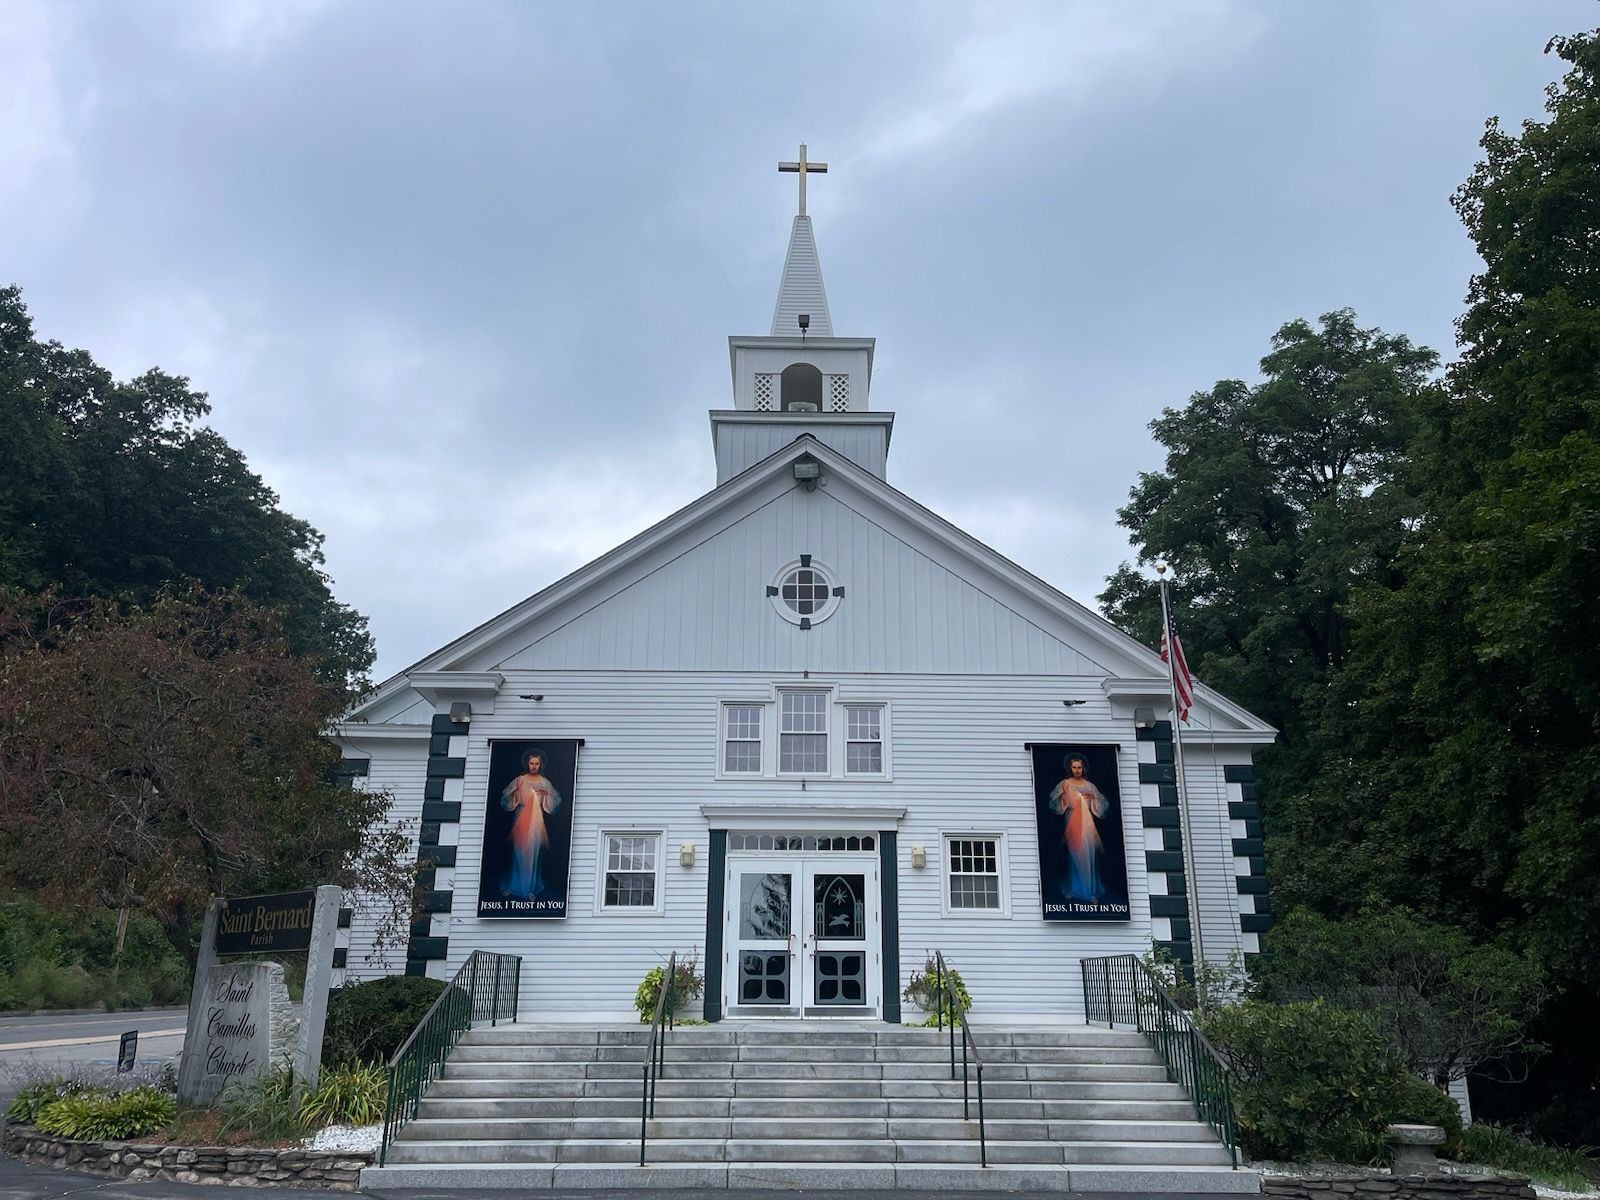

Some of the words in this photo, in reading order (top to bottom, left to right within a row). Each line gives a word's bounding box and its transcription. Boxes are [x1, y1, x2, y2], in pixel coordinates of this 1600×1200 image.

[220, 908, 253, 935] Saint
[254, 899, 312, 932] Bernard
[511, 901, 535, 909] TRUST
[548, 901, 564, 909] YOU
[1074, 904, 1098, 912] TRUST
[1110, 904, 1128, 912] YOU
[250, 933, 273, 946] Parish
[216, 973, 253, 1003] Saint
[207, 1007, 256, 1039] Camillus
[206, 1043, 255, 1076] Church
